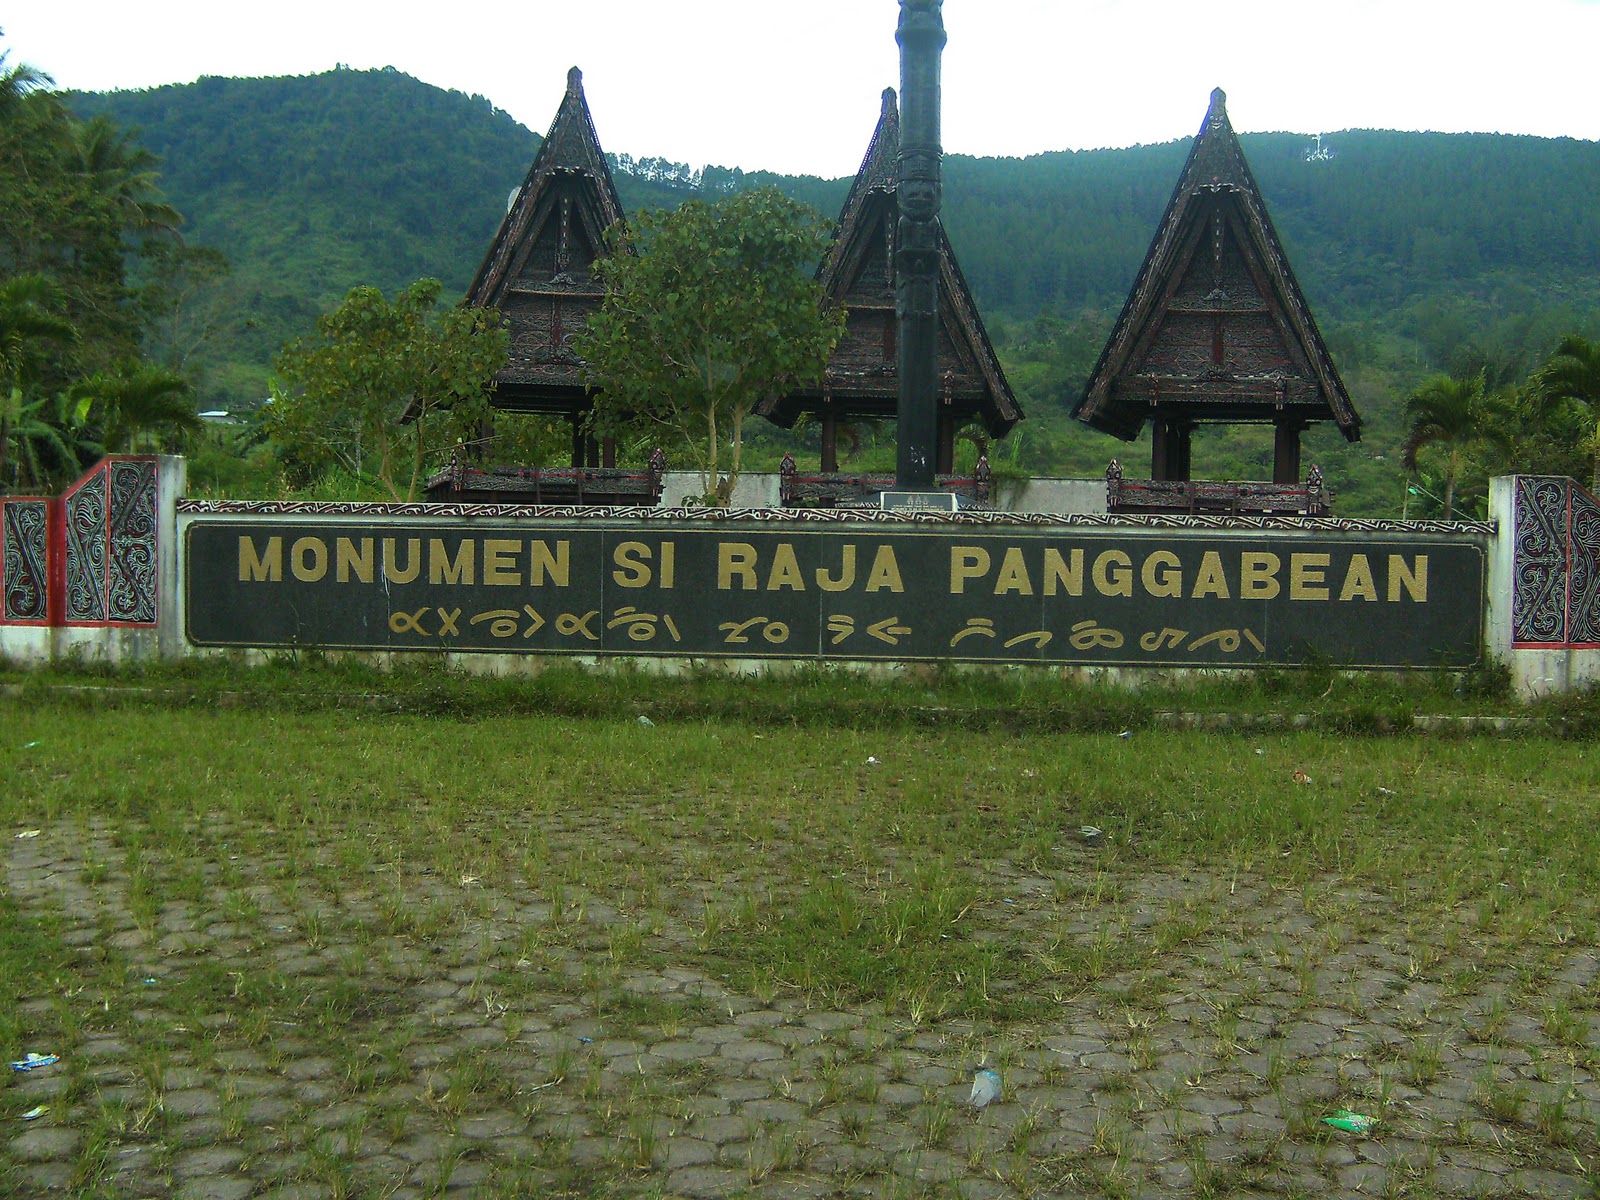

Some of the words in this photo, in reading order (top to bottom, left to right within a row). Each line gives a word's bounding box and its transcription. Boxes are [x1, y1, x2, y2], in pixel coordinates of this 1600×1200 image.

[239, 535, 570, 587] MONUMEN
[612, 541, 675, 589] SI
[717, 542, 905, 593] RAJA
[950, 545, 1428, 602] PANGGABEAN
